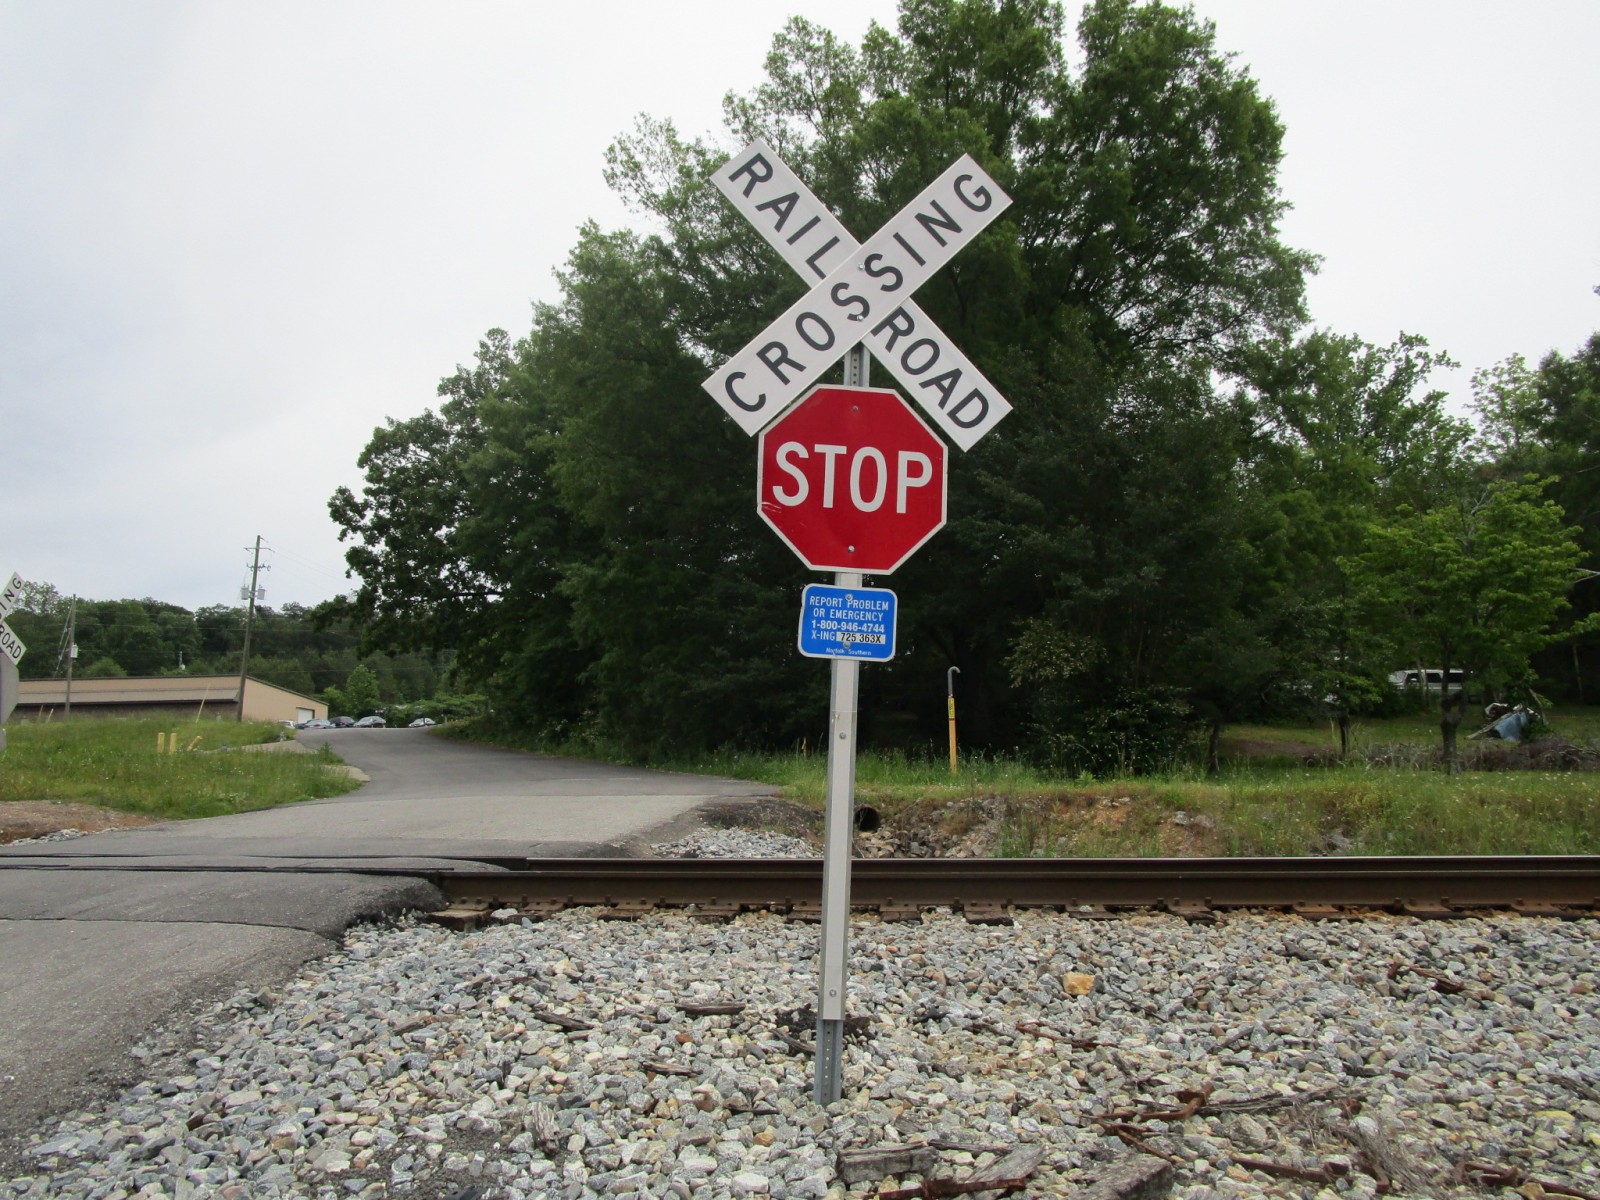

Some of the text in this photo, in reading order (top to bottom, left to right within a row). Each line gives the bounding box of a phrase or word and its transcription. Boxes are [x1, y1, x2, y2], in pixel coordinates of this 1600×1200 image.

[725, 174, 992, 412] CROSSING
[728, 152, 990, 429] RAIL ROAD
[772, 441, 933, 514] STOP
[809, 596, 889, 611] REPORT PROBLEM
[813, 608, 884, 622] OR EMERGENCY
[811, 620, 885, 633] 1-800-946-4744
[811, 630, 881, 644] X-ING 725 363X
[848, 648, 872, 656] Southern
